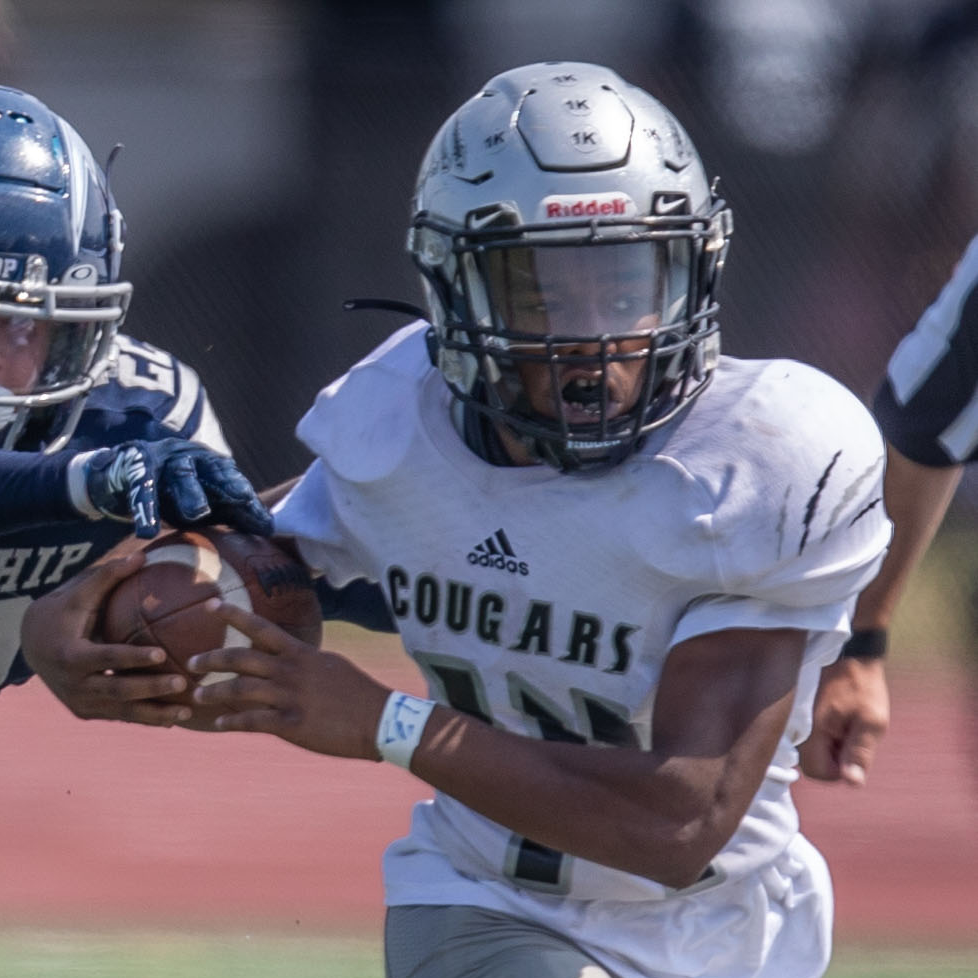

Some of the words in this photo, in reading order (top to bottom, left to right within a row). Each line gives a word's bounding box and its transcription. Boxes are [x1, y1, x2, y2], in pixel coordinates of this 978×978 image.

[565, 99, 590, 110] 1K
[484, 131, 505, 148] 1K
[571, 131, 597, 145] 1K
[546, 198, 626, 218] Riddell
[466, 551, 529, 576] adidas
[386, 564, 644, 676] COUGARS
